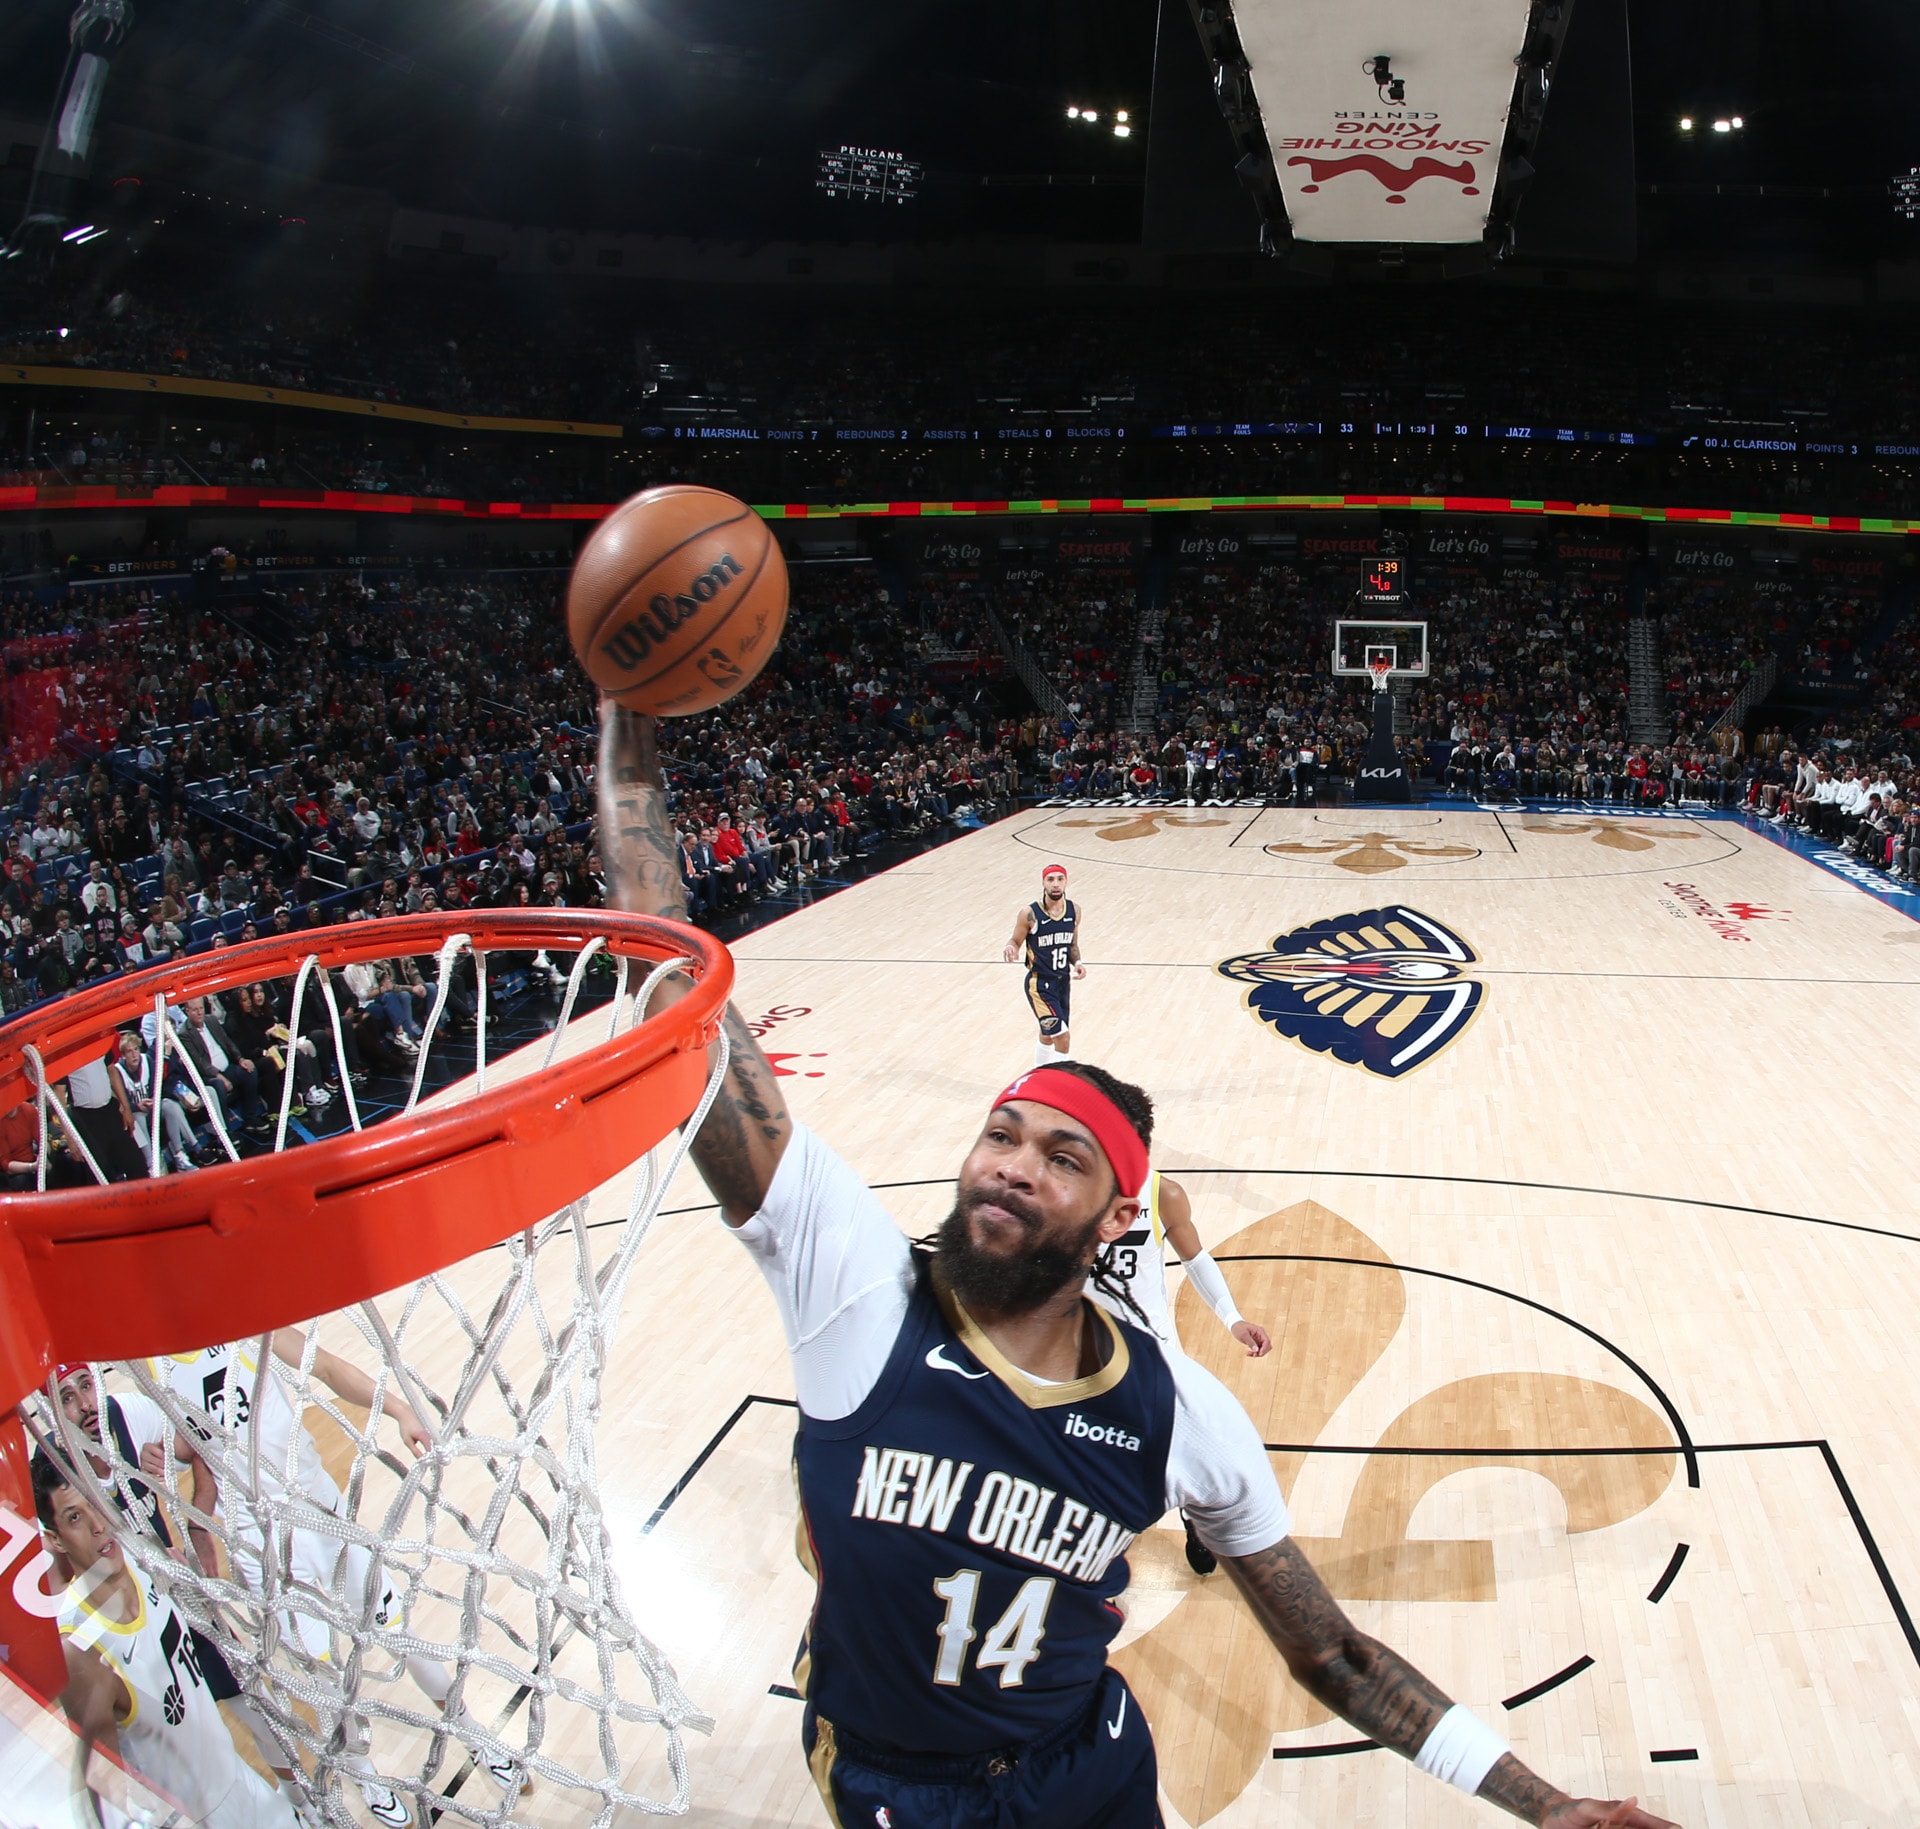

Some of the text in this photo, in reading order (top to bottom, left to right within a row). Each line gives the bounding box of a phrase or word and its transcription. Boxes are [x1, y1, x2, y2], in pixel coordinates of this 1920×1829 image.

[1334, 111, 1438, 119] CENTER
[840, 145, 903, 161] PELICANS
[1279, 137, 1491, 155] SMOOTHIE
[674, 427, 1125, 441] 8 N. MARSHALL POINTS 7 REBOUNDS 2 ASSISTS 1 STEALS 0 BLOCKS 0
[1340, 423, 1353, 433] 33
[1455, 425, 1468, 435] 30
[1505, 427, 1531, 438] JAZZ
[1705, 438, 1920, 455] 00 J. CLARKSON POINTS 3 REBOUN
[1058, 541, 1133, 557] SEATGEEK
[1180, 538, 1239, 553] Let's Go
[1303, 538, 1380, 553] SEATGEEK
[1429, 538, 1489, 554] Let's Go
[1558, 544, 1623, 561] SEATGEEK
[108, 560, 177, 573] BETRIVERS
[256, 556, 315, 566] BETRIVERS
[348, 556, 400, 565] BETRIVERS
[1675, 550, 1734, 567] Let's Go
[1378, 562, 1398, 573] 1:39
[1526, 569, 1539, 579] Go
[602, 552, 745, 672] Wilson
[1035, 799, 1266, 808] PELICANS
[1539, 807, 1708, 819] FANDUEL
[1663, 882, 1725, 918] SMOOTHIE
[1051, 947, 1068, 971] 15
[1064, 1412, 1143, 1452] ibotta
[851, 1446, 974, 1533] NEW
[933, 1568, 1056, 1689] 14
